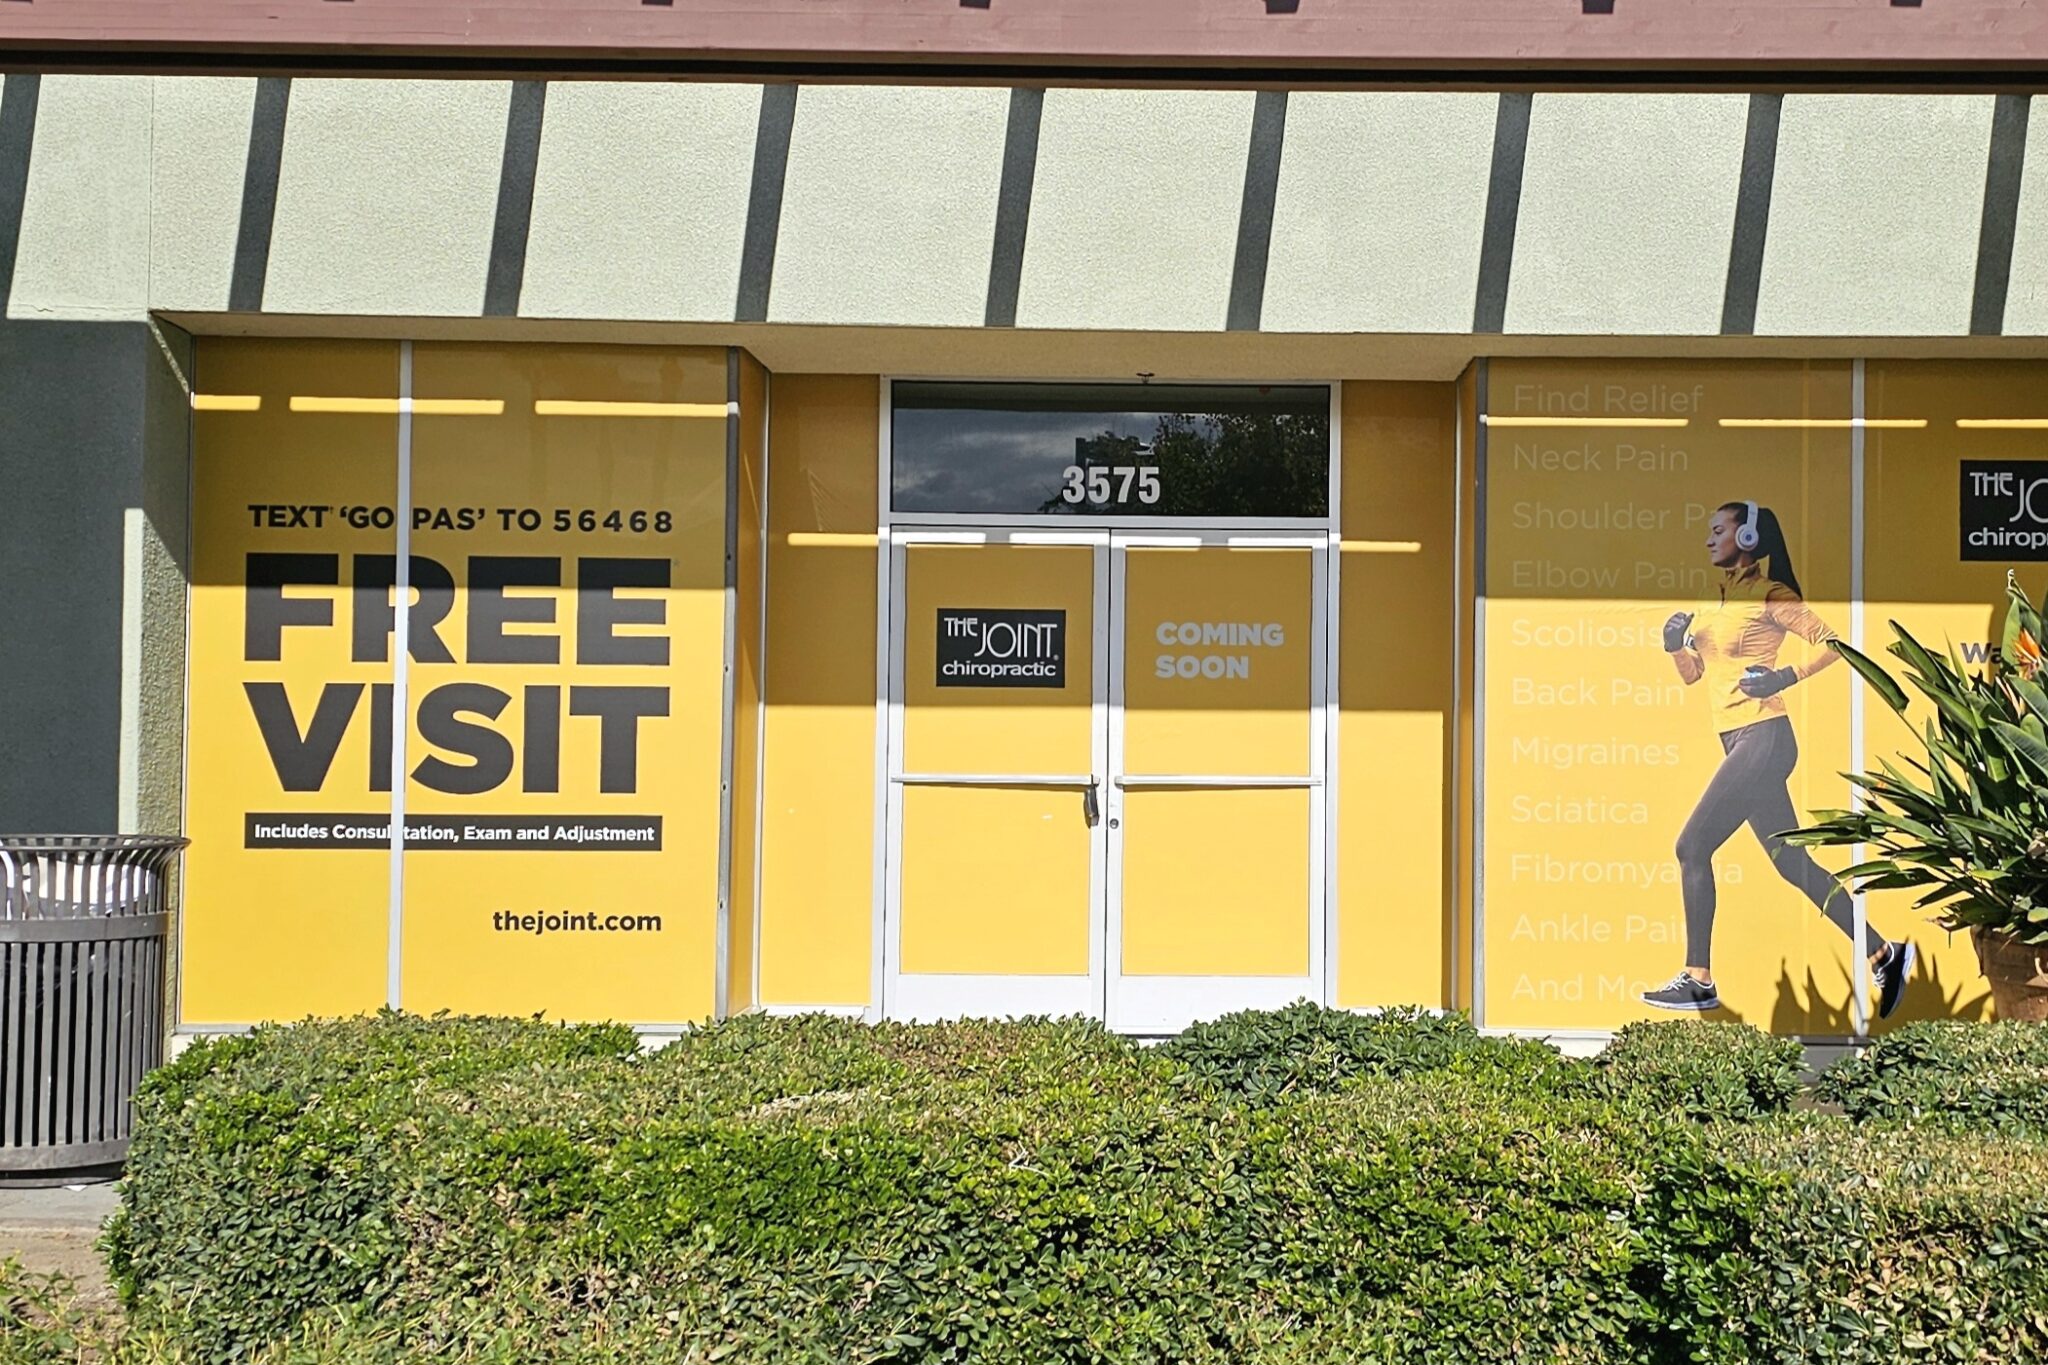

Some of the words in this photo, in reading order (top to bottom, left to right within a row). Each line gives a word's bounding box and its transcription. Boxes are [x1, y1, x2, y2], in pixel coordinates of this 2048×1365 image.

[1513, 384, 1590, 412] Find
[1604, 384, 1704, 413] Relief
[1513, 444, 1601, 471] Neck
[1616, 444, 1688, 471] Pain
[1062, 466, 1160, 504] 3575
[1969, 472, 2014, 496] THE
[497, 509, 541, 531] TO
[553, 510, 673, 533] 56468
[1512, 502, 1670, 530] Shoulder
[1968, 527, 2048, 549] chirop
[1513, 560, 1621, 589] Elbow
[1635, 561, 1708, 589] Pain
[244, 552, 672, 666] FREE
[944, 617, 978, 637] THE
[974, 622, 1058, 658] JOINT
[1156, 622, 1284, 647] COMING
[1511, 619, 1663, 648] Scoliosis
[942, 660, 1056, 678] chiropractic
[1155, 655, 1249, 679] SOON
[1511, 678, 1599, 706] Back
[1611, 678, 1685, 706] Pain
[242, 682, 671, 795] VISIT
[1511, 736, 1680, 770] Migraines
[1511, 795, 1649, 824] Sciatica
[254, 823, 328, 838] Includes
[463, 826, 512, 840] Exam
[516, 826, 549, 840] and
[553, 826, 655, 843] Adjustment
[1511, 854, 1743, 889] Fibromyaia
[493, 910, 662, 935] thejoint.com
[1510, 914, 1612, 943] Ankle
[1625, 914, 1686, 943] Pai
[1510, 974, 1583, 1001] And
